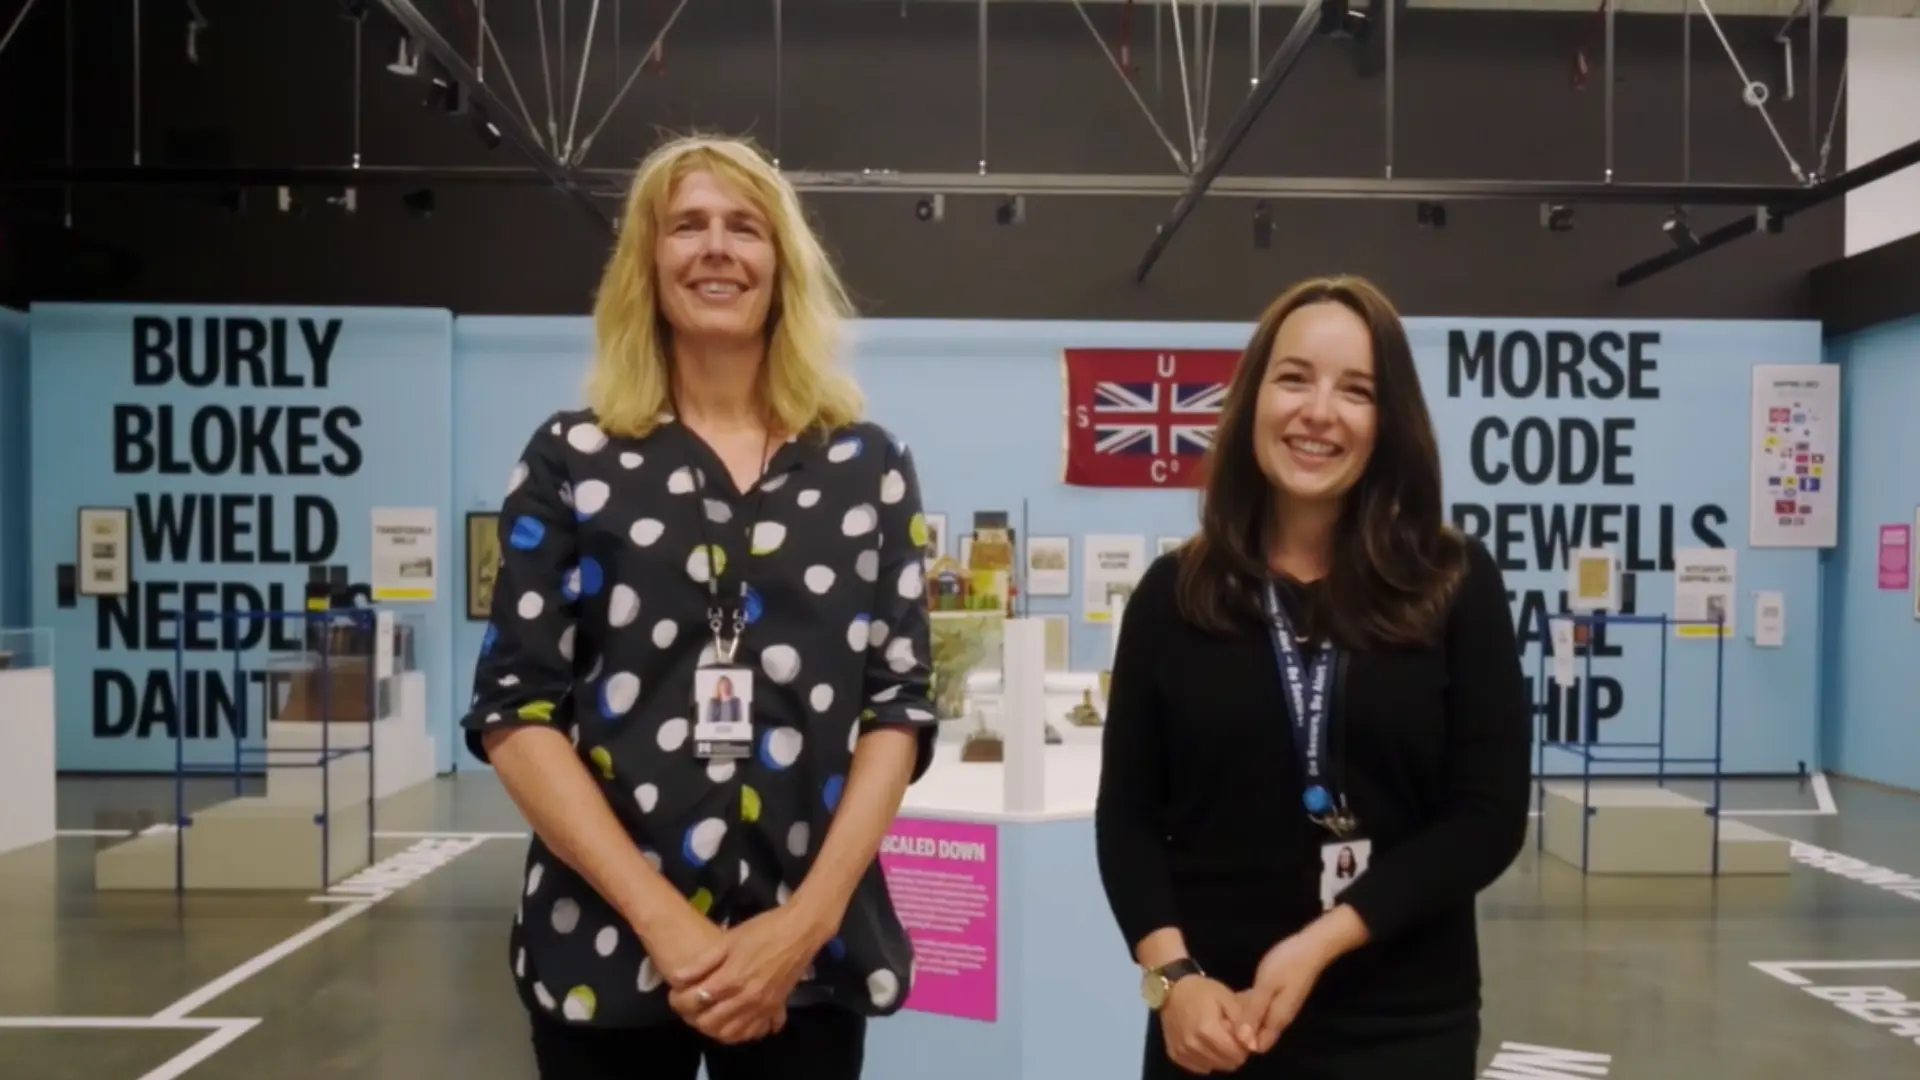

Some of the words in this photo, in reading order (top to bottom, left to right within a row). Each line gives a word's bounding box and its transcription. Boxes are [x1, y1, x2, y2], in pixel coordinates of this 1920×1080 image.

[133, 316, 343, 388] BURLY
[1157, 354, 1175, 378] U
[1447, 329, 1661, 399] MORSE
[113, 403, 363, 477] BLOKES
[1075, 405, 1089, 428] S
[1470, 415, 1636, 487] CODE
[134, 493, 339, 564] WIELD
[1451, 503, 1729, 572] REWELLS
[96, 580, 374, 651] NEEDL
[93, 667, 291, 739] DAINT
[1522, 675, 1625, 743] HIP
[938, 840, 985, 861] DOWN
